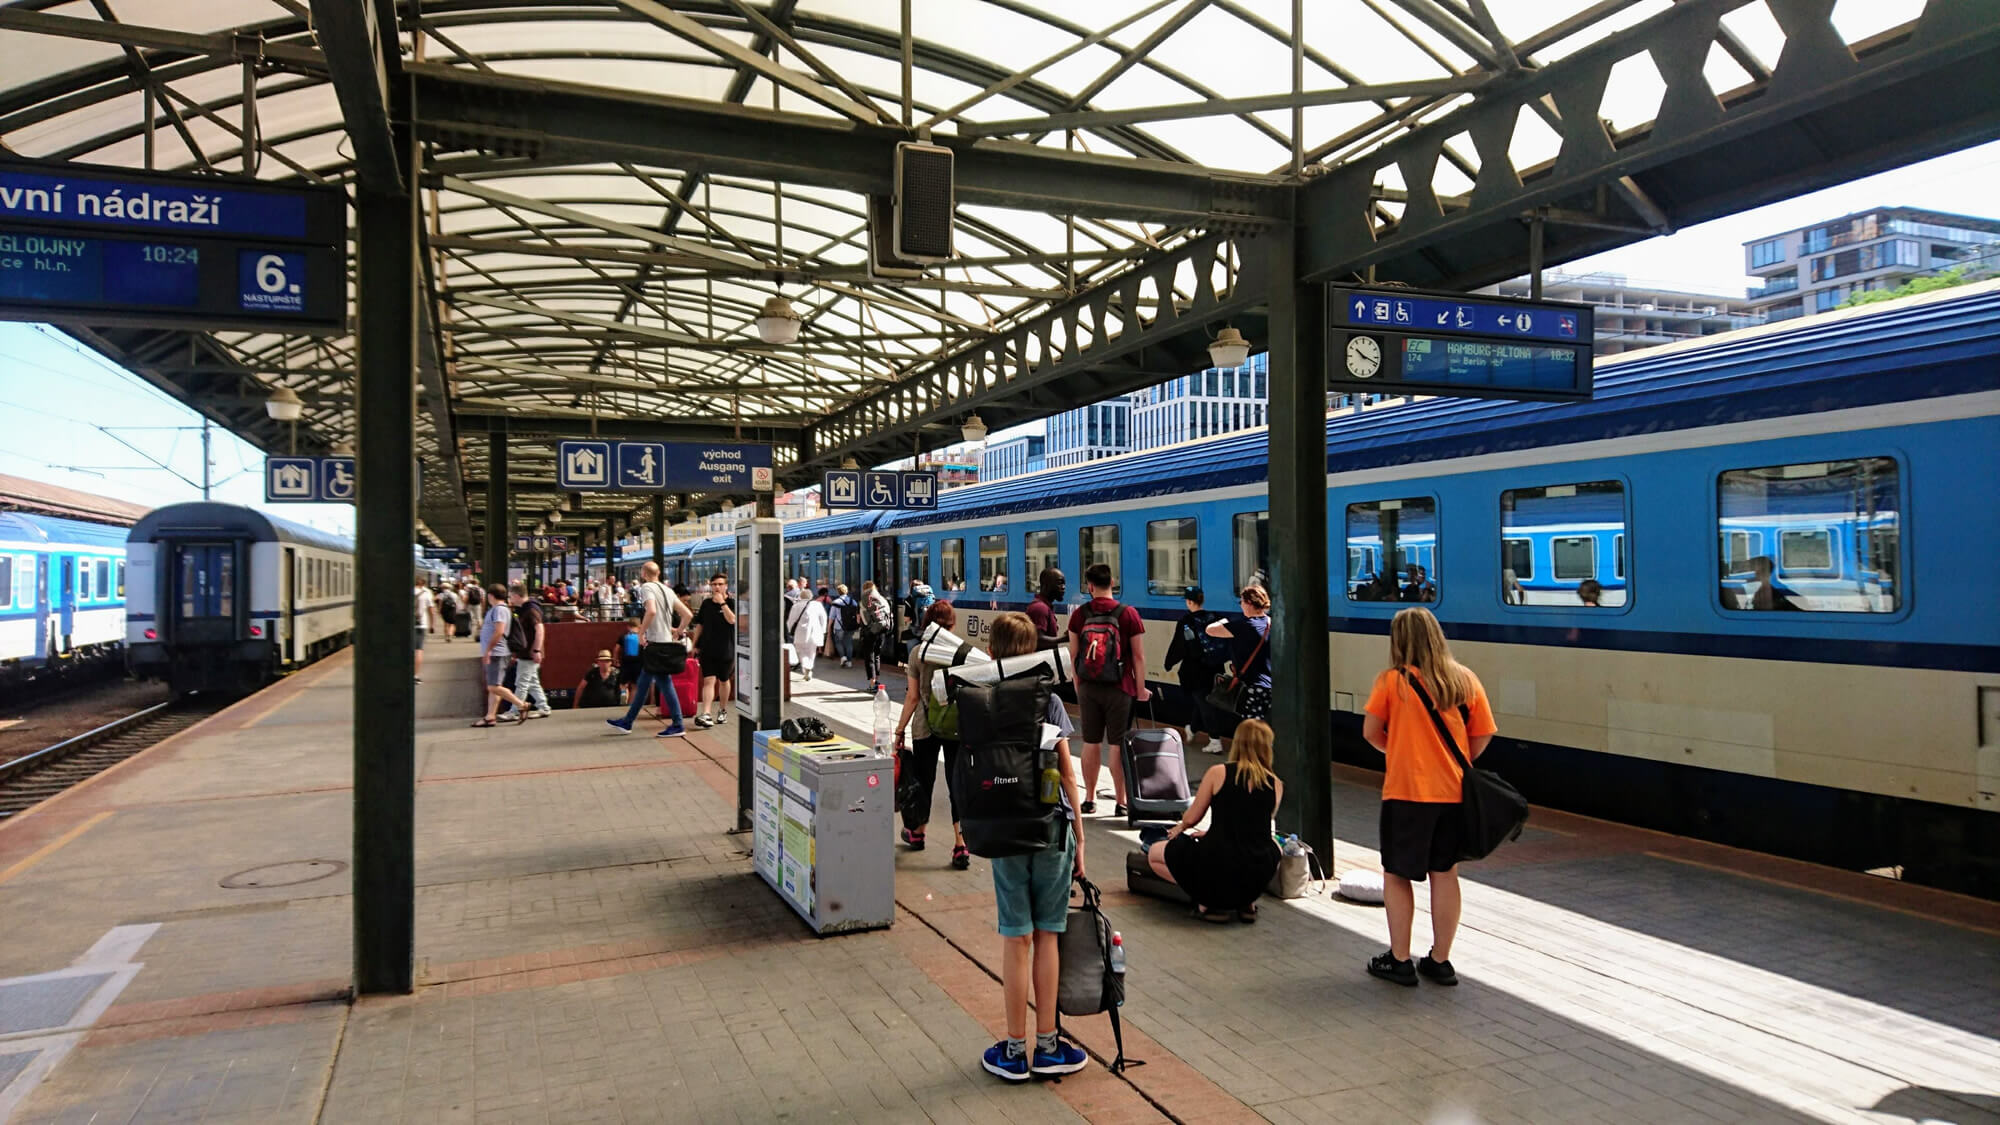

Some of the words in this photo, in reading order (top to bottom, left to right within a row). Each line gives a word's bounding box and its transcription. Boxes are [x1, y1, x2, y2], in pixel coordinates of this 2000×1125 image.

[77, 189, 222, 225] nádraží
[142, 245, 199, 265] 10:24
[256, 254, 300, 293] 6.
[1408, 340, 1425, 352] EC
[1447, 342, 1532, 360] HAMBURG-ALTONA
[1408, 353, 1422, 362] 174
[1463, 356, 1486, 367] Berlin
[703, 449, 741, 460] východ
[699, 461, 745, 473] Ausgang
[712, 474, 732, 484] exit
[994, 775, 1018, 785] fitness
